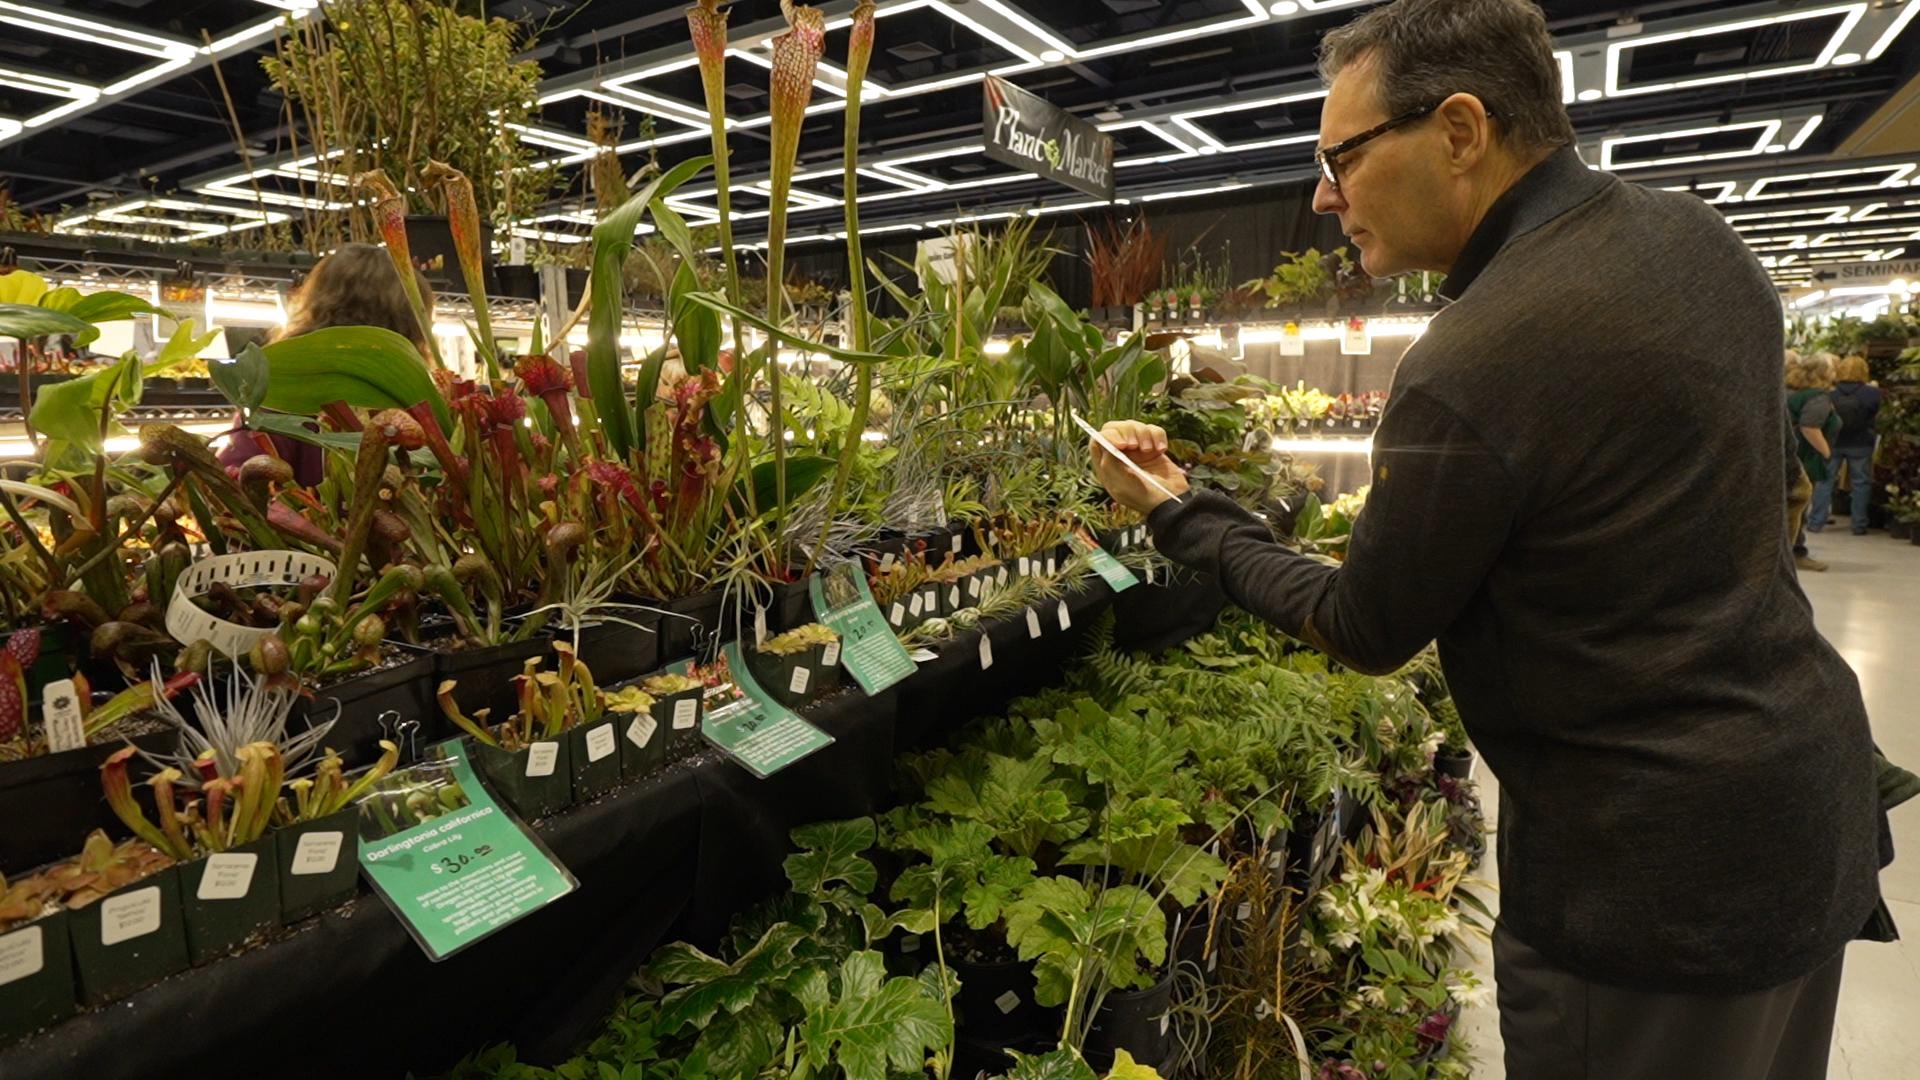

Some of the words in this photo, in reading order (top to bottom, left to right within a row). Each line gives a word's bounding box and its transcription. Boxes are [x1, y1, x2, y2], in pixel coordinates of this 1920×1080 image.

[993, 105, 1046, 161] Plant
[1056, 128, 1108, 188] Market
[366, 829, 438, 861] Darlingtonia
[438, 806, 493, 832] californica
[422, 840, 448, 853] Cobra
[447, 834, 462, 844] Lily
